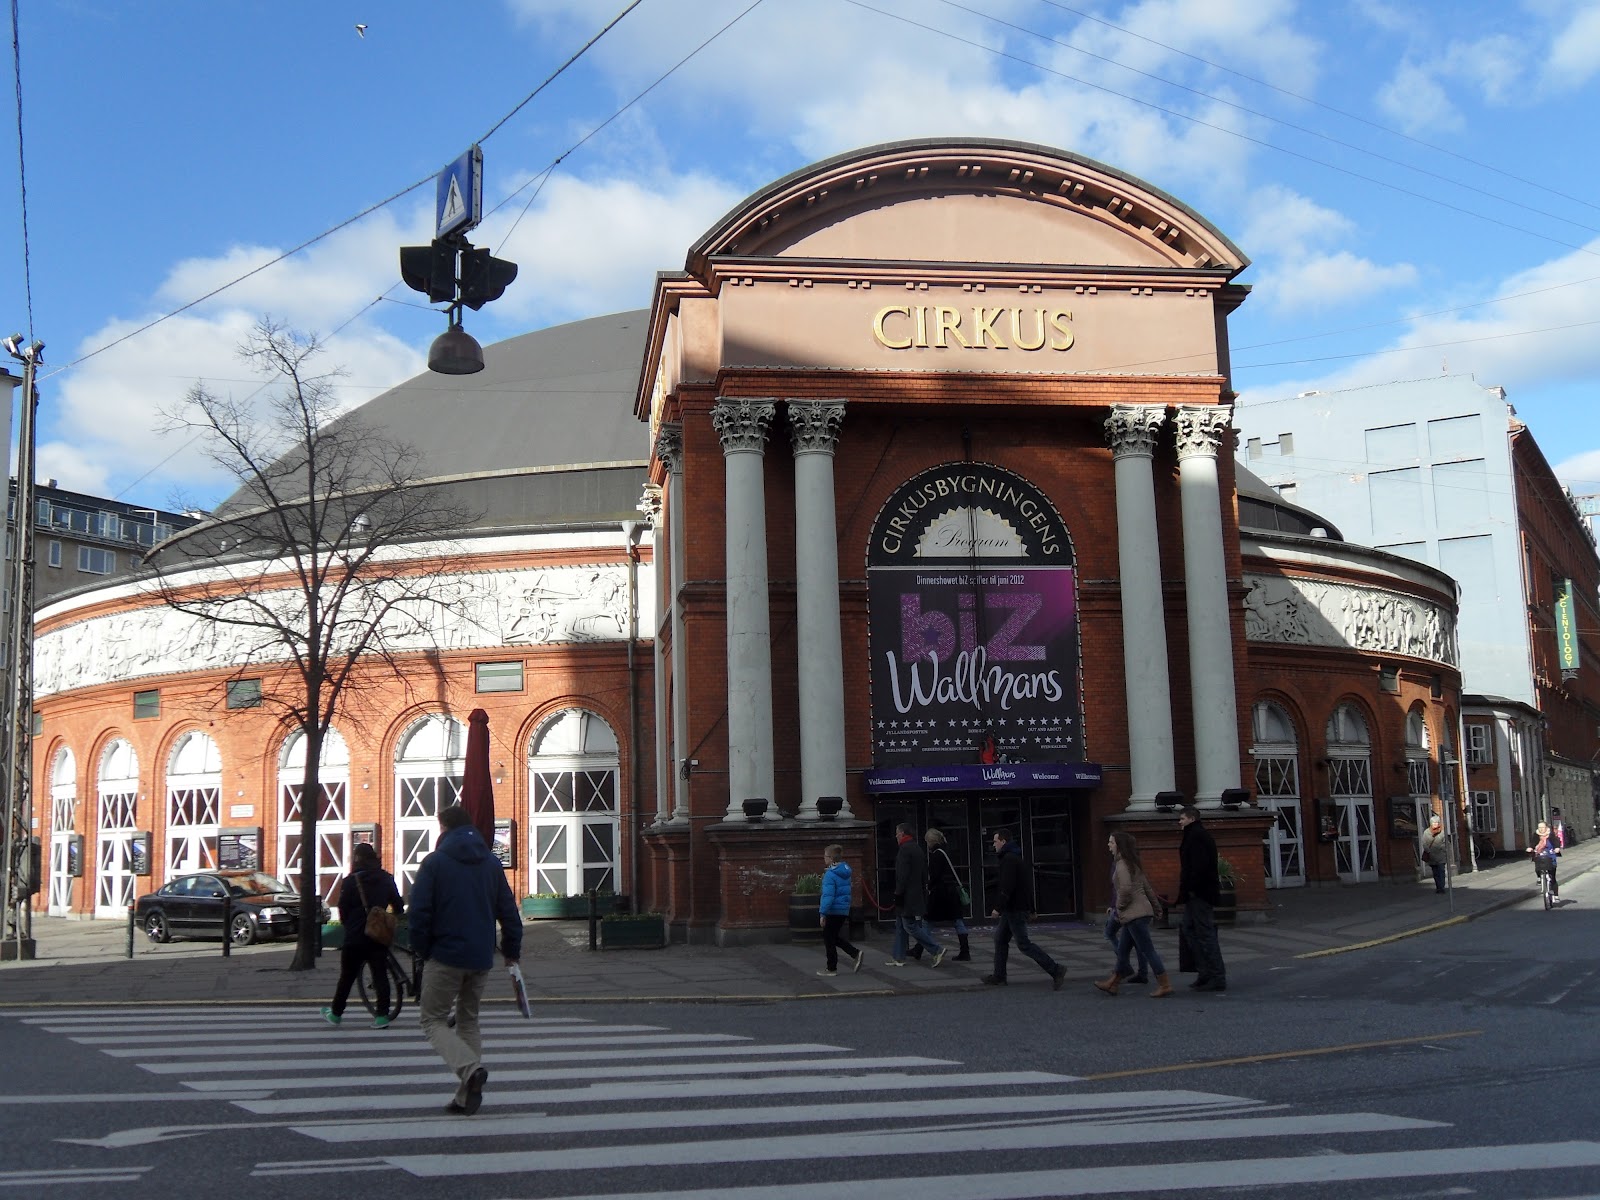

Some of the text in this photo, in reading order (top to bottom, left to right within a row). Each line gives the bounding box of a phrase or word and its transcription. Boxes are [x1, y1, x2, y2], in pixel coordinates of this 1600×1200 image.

[873, 305, 1075, 351] CIRKUS
[882, 475, 1060, 556] CIRKUSBYGNINGENS
[935, 523, 1010, 554] Program
[916, 574, 958, 586] Dinnershowet
[997, 574, 1009, 587] juni
[1009, 574, 1025, 585] 2012
[885, 645, 1063, 714] Wallmans
[868, 778, 906, 786] Velkommen
[921, 776, 959, 784] Bienvenue
[982, 767, 1017, 781] Wallmans
